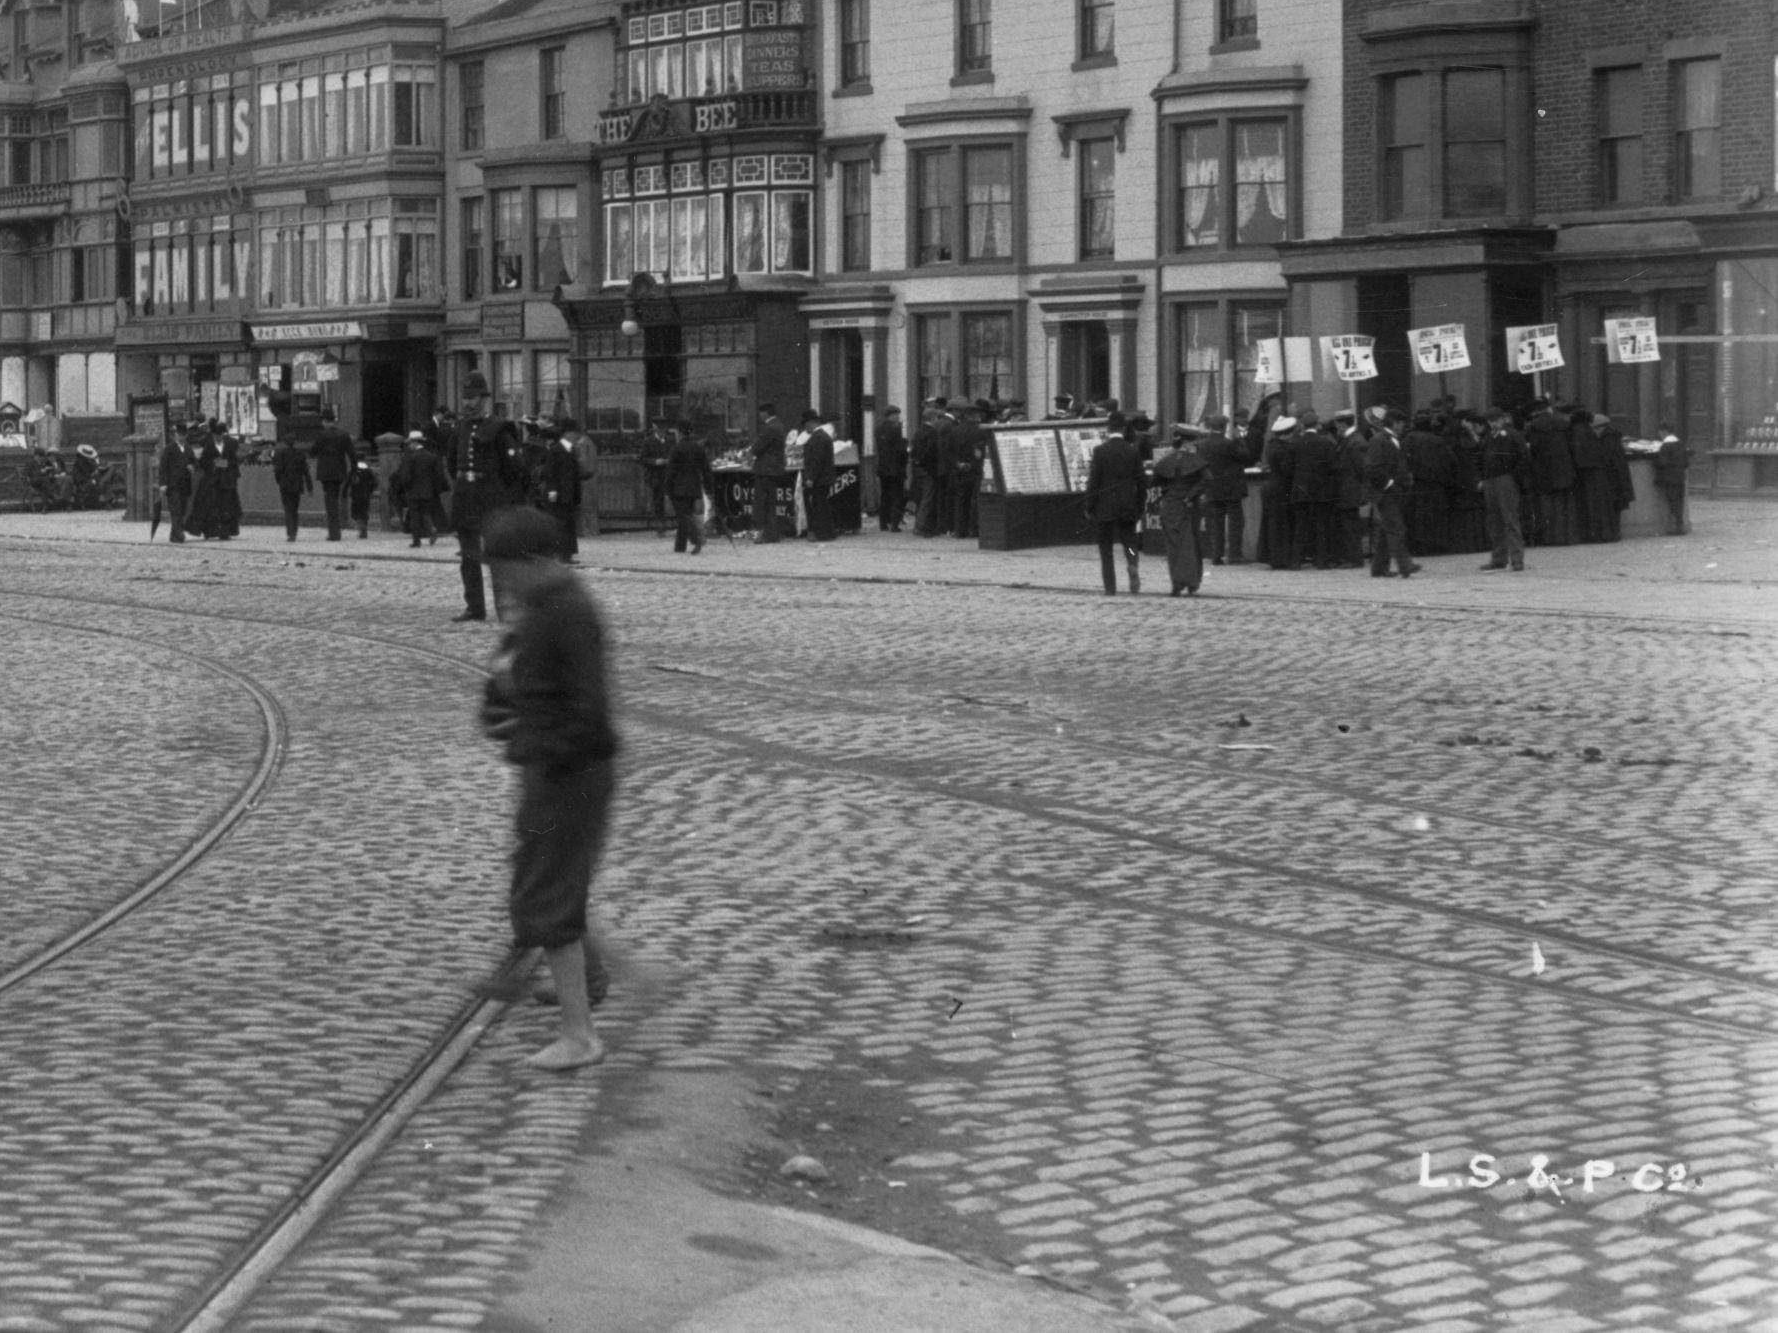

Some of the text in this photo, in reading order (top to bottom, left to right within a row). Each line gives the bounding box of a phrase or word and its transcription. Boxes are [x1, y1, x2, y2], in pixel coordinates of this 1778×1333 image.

[747, 45, 800, 59] DINNERS
[139, 55, 237, 81] PHRENOLOGY
[752, 60, 795, 73] TEAS
[153, 99, 249, 166] ELLIS
[595, 101, 737, 142] THE BEE
[135, 242, 250, 305] FAMILY
[733, 483, 793, 501] OYSRS
